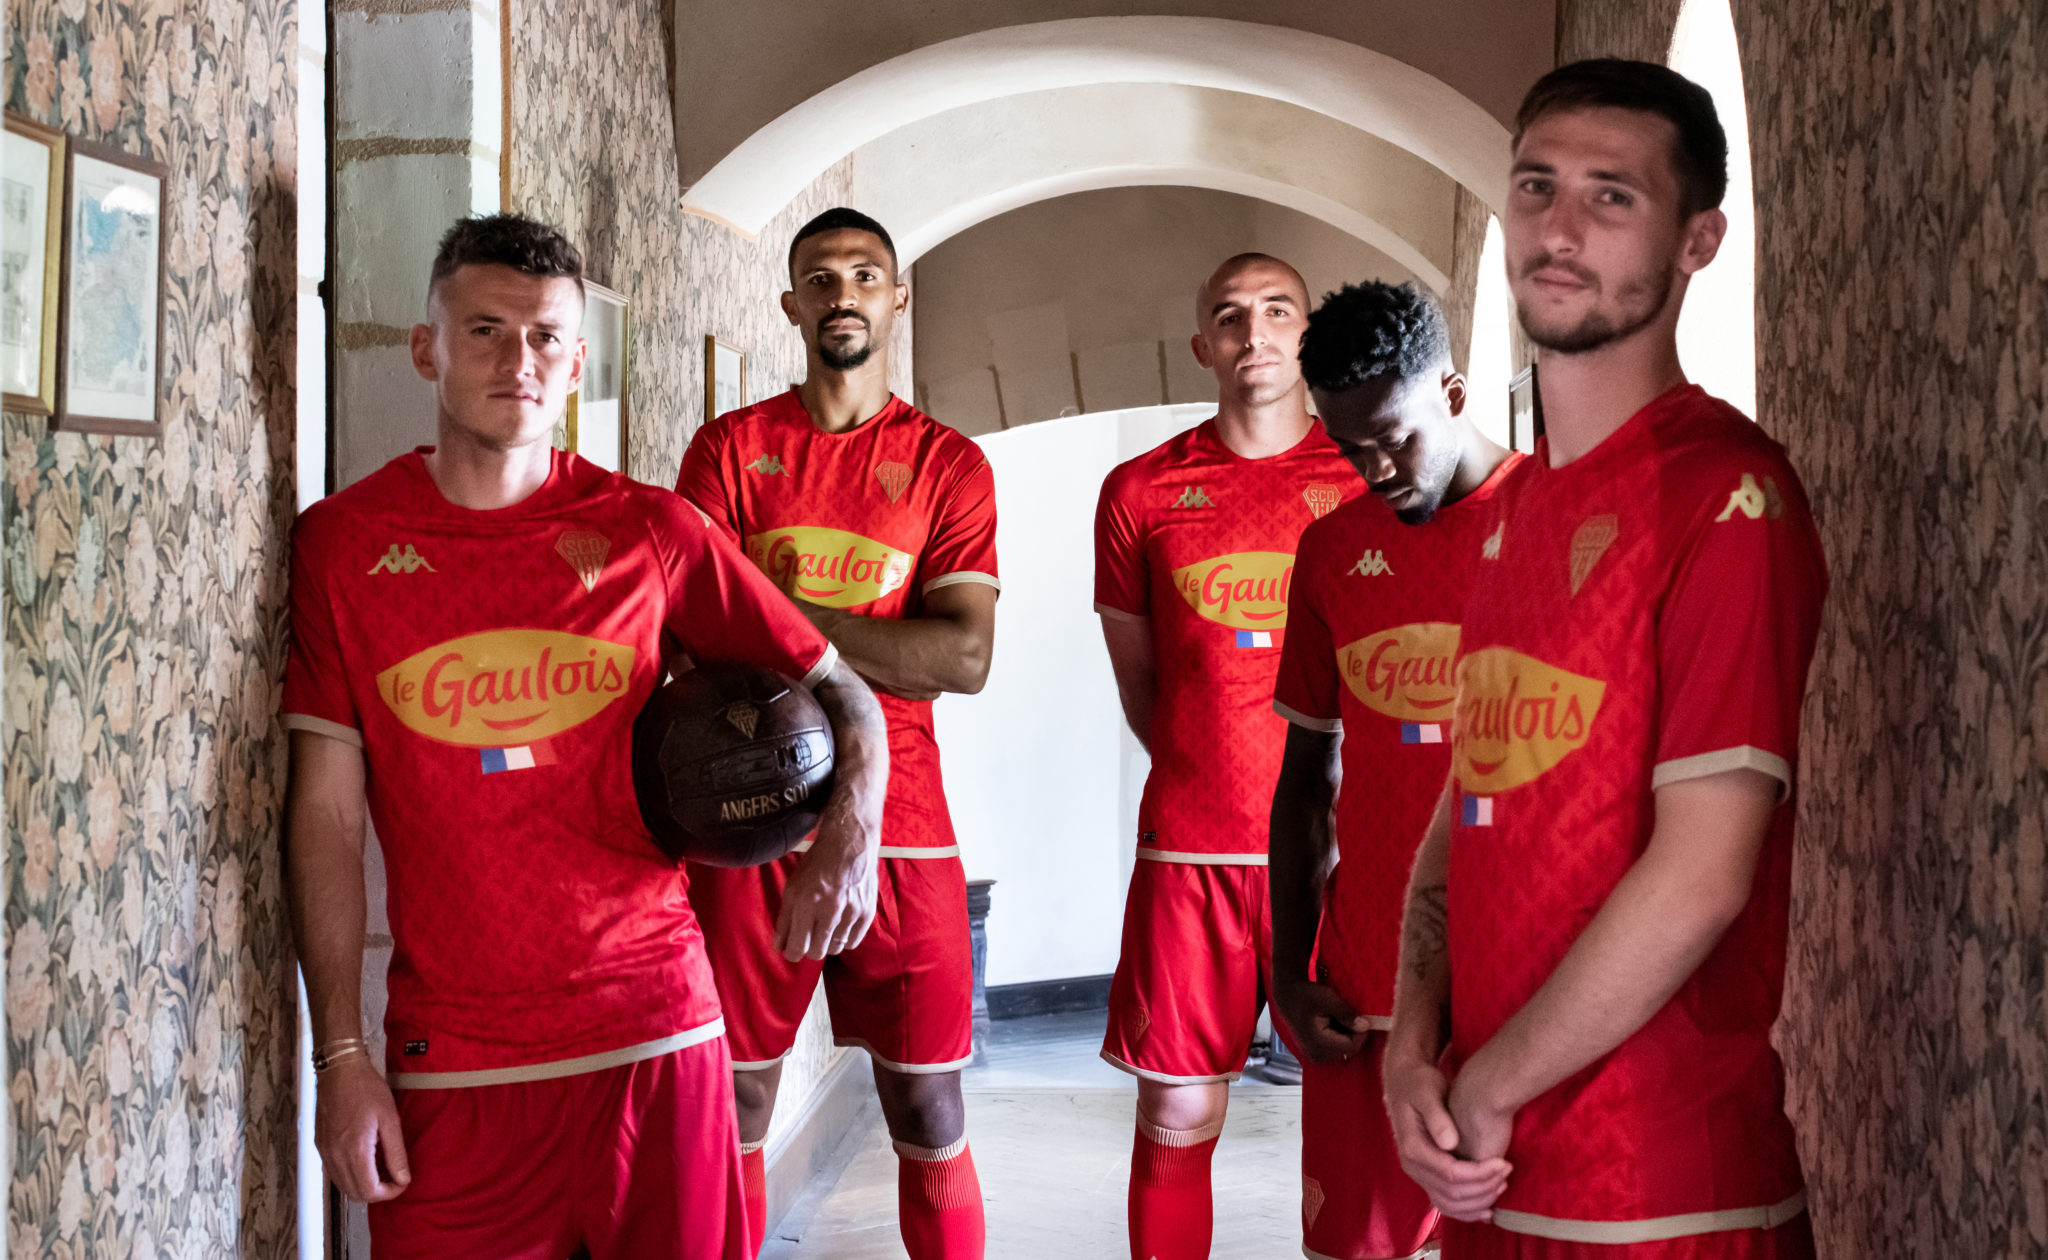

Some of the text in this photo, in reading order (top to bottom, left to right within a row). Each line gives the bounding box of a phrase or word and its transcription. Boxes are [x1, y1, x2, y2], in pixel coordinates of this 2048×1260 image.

[1310, 489, 1335, 502] SCO
[1183, 563, 1294, 614] le Gaul
[1347, 650, 1363, 677] le
[392, 647, 624, 728] le Gaulois
[721, 792, 780, 820] ANGERS
